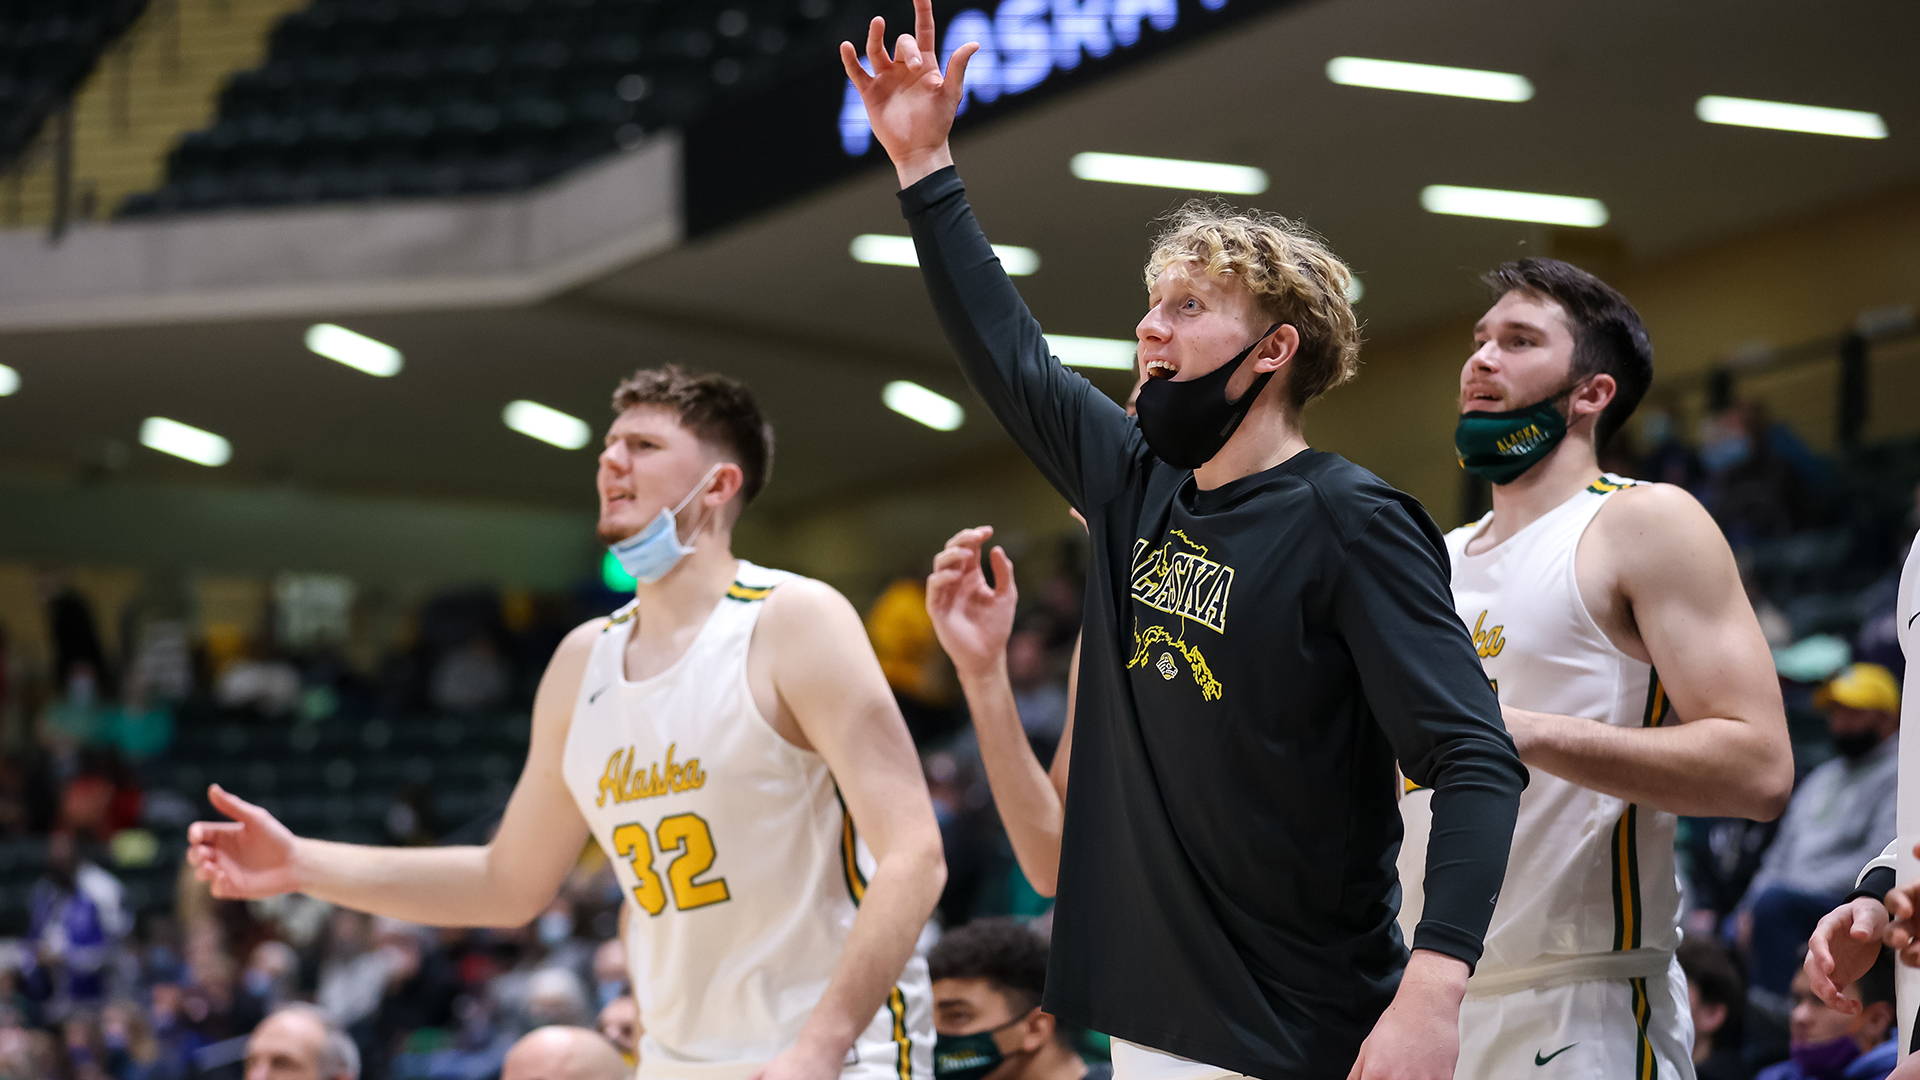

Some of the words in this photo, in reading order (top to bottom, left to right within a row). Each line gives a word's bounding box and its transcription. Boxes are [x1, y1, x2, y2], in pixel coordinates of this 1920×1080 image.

[838, 0, 1179, 156] ASK
[1496, 423, 1541, 452] ALASKA
[597, 743, 706, 807] Alaska
[613, 812, 730, 917] 32
